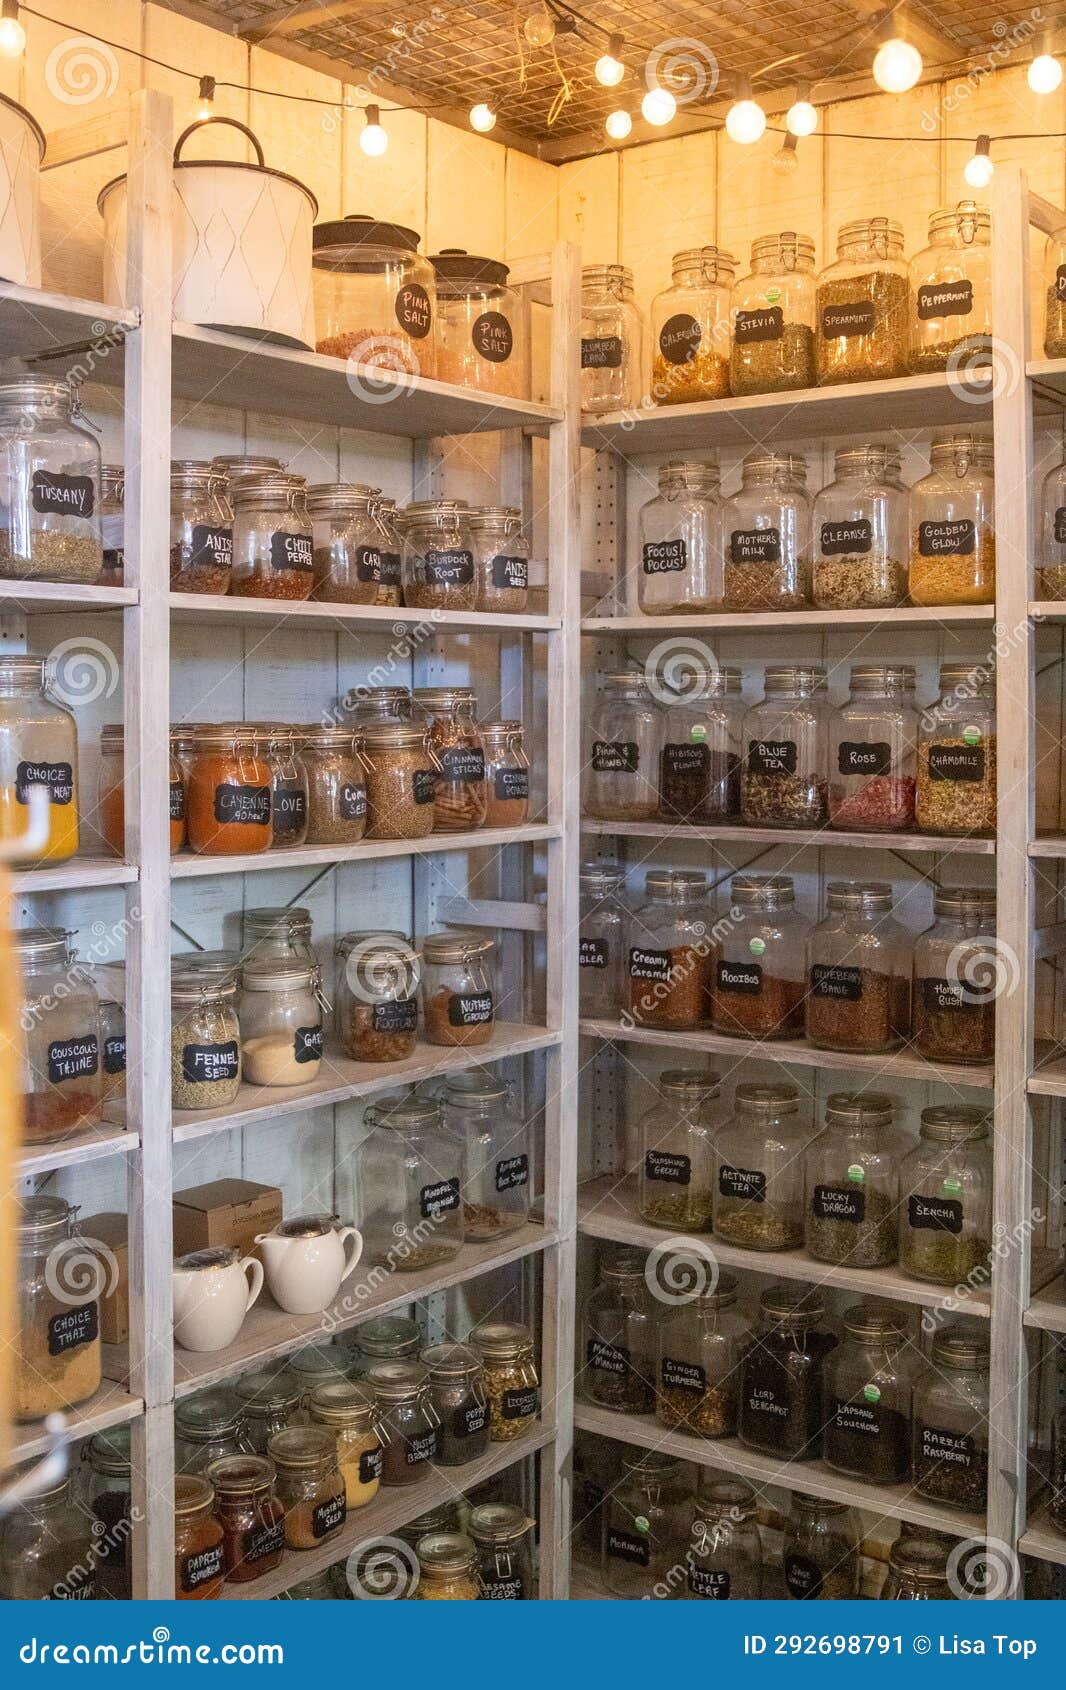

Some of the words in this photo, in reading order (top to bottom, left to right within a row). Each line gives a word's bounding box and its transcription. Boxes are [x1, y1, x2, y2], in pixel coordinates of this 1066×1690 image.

[403, 291, 429, 314] PINK
[921, 290, 970, 307] PEPPERMINT
[404, 310, 428, 327] SALT
[740, 316, 775, 331] STEVIA
[825, 314, 872, 326] SPEARMINT
[480, 322, 508, 338] PINK
[481, 340, 508, 353] SALT
[37, 484, 86, 511] TUSCANY
[822, 528, 867, 545] CLEANSE
[925, 525, 968, 537] GOLDEN
[931, 537, 961, 549] GLOW
[741, 547, 765, 556] MILK
[434, 567, 462, 579] ROOT
[757, 744, 788, 757] BLUE
[849, 751, 877, 764] ROSE
[762, 758, 784, 769] TEA
[930, 755, 978, 766] CHAMOMILE
[26, 768, 66, 781] CHOICE
[632, 950, 668, 967] Creamy
[51, 1042, 97, 1060] COUSCOUS
[194, 1051, 237, 1066] FENNEL
[204, 1065, 229, 1079] SEED
[722, 1171, 760, 1184] ACTIVATE
[731, 1182, 749, 1193] TEA
[821, 1191, 849, 1205] LUCKY
[822, 1202, 856, 1214] DRAGON
[916, 1205, 955, 1219] SENCHA
[53, 1311, 91, 1333] CHOICE
[58, 1326, 85, 1345] THAI
[837, 1404, 874, 1419] LAPSANG
[923, 1430, 967, 1449] RAZZLE
[923, 1445, 971, 1466] RASPBERRY
